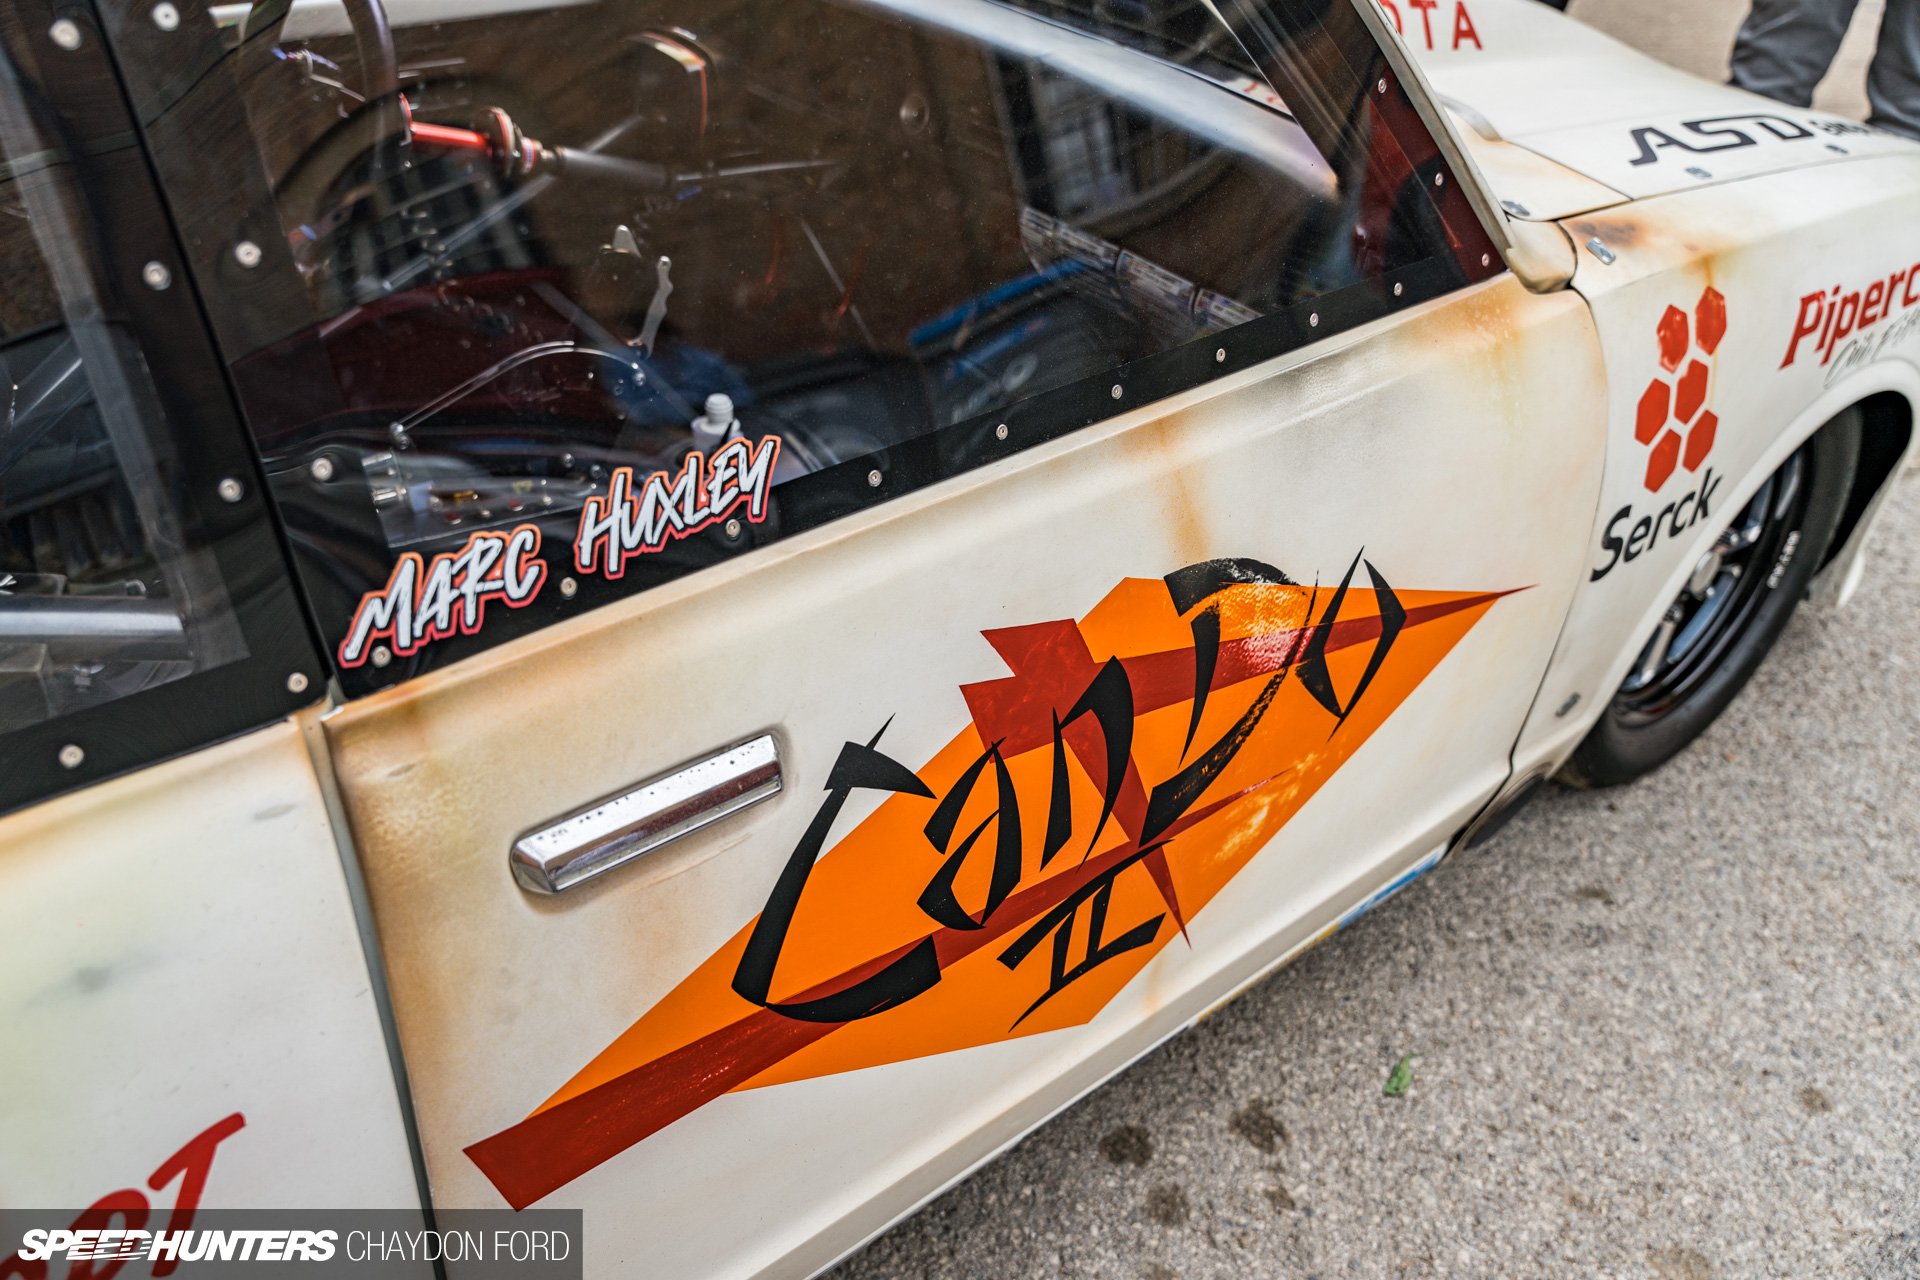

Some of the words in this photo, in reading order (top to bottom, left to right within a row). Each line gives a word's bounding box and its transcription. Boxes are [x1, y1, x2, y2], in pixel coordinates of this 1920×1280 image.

[1629, 114, 1815, 167] ASD
[338, 523, 548, 669] MARC
[574, 435, 782, 580] HUXLEY
[1589, 467, 1723, 583] Serck
